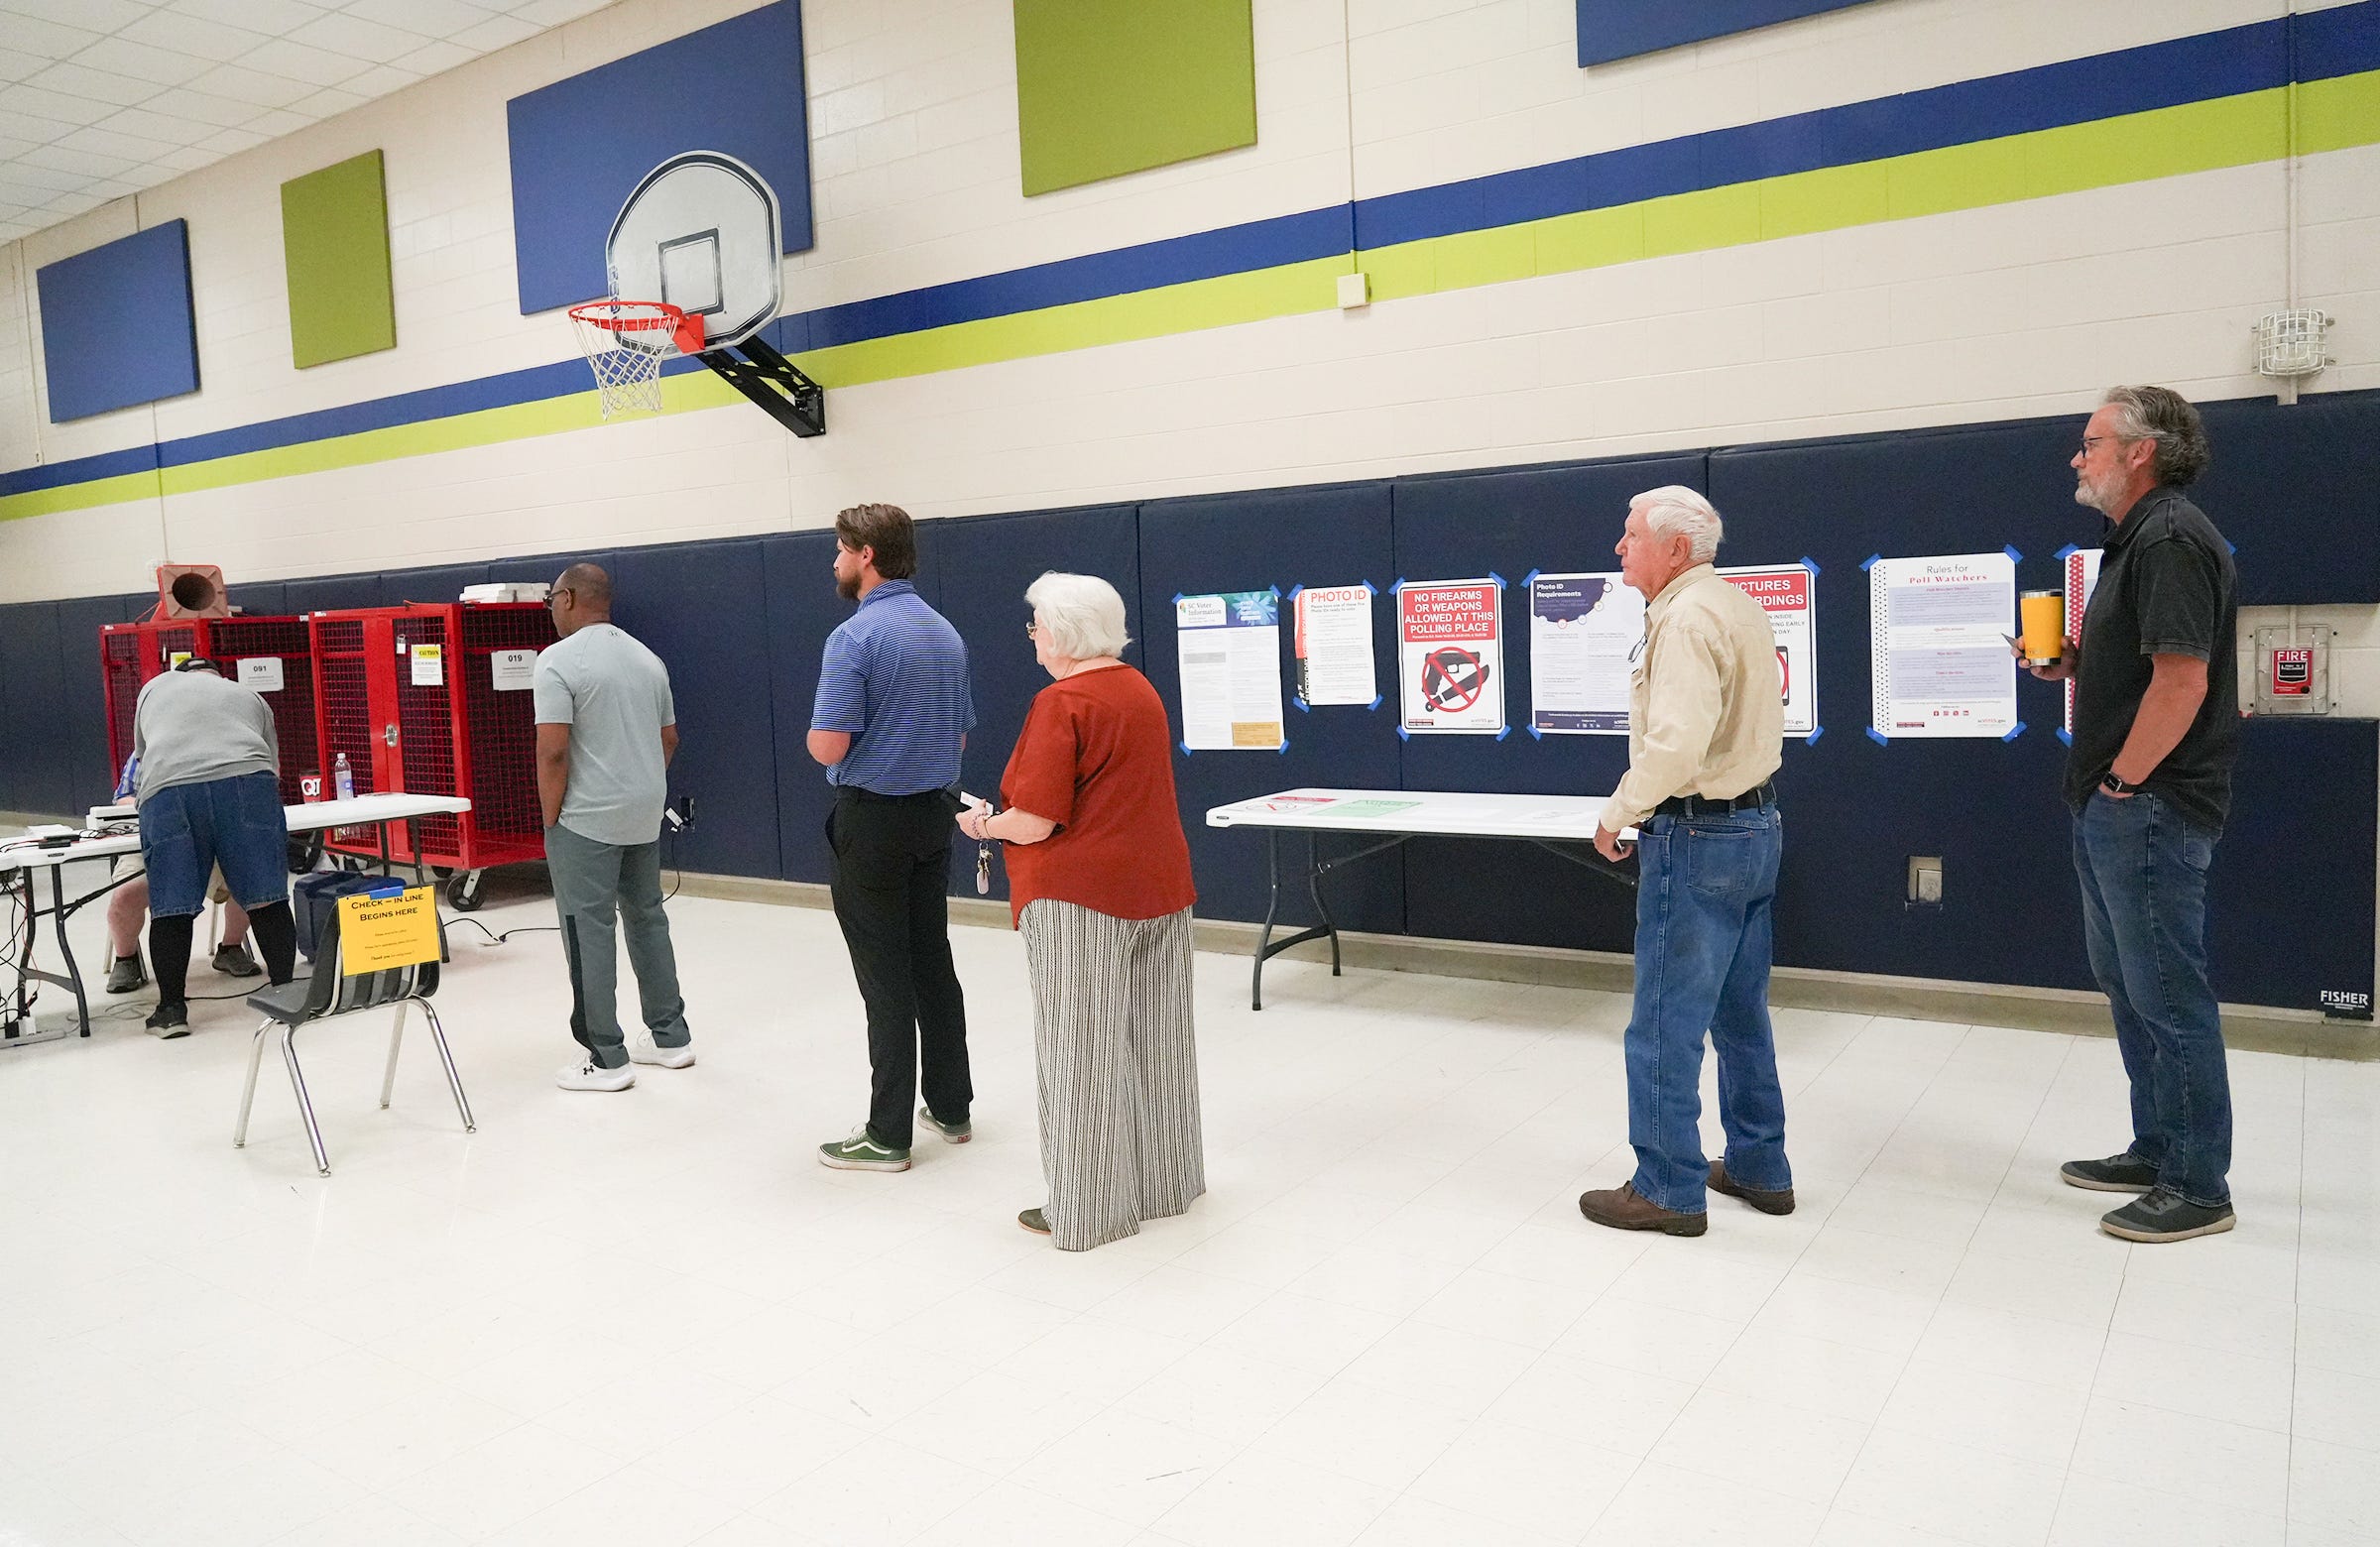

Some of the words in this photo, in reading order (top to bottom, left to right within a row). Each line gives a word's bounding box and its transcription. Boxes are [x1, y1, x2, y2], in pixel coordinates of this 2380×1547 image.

[1927, 565, 1952, 574] Rules
[1935, 574, 1987, 583] Watchers
[1311, 590, 1352, 603] PHOTO
[1355, 589, 1367, 600] ID
[1414, 593, 1429, 602] NO
[1431, 591, 1483, 601] FIREARMS
[1754, 593, 1804, 606] RDINGS
[1414, 603, 1430, 613] OR
[1431, 602, 1483, 612] WEAPONS
[1404, 613, 1453, 624] ALLOWED
[1455, 613, 1469, 622] AT
[1471, 611, 1494, 621] THIS
[1410, 624, 1453, 634] POLLING
[1455, 622, 1488, 633] PLACE
[2277, 651, 2309, 661] FIRE
[300, 777, 321, 796] QT
[351, 898, 383, 909] CHECK
[405, 893, 423, 902] LINE
[360, 910, 394, 921] BEGINS
[395, 907, 418, 916] HERE
[2320, 990, 2368, 1006] FISHER
